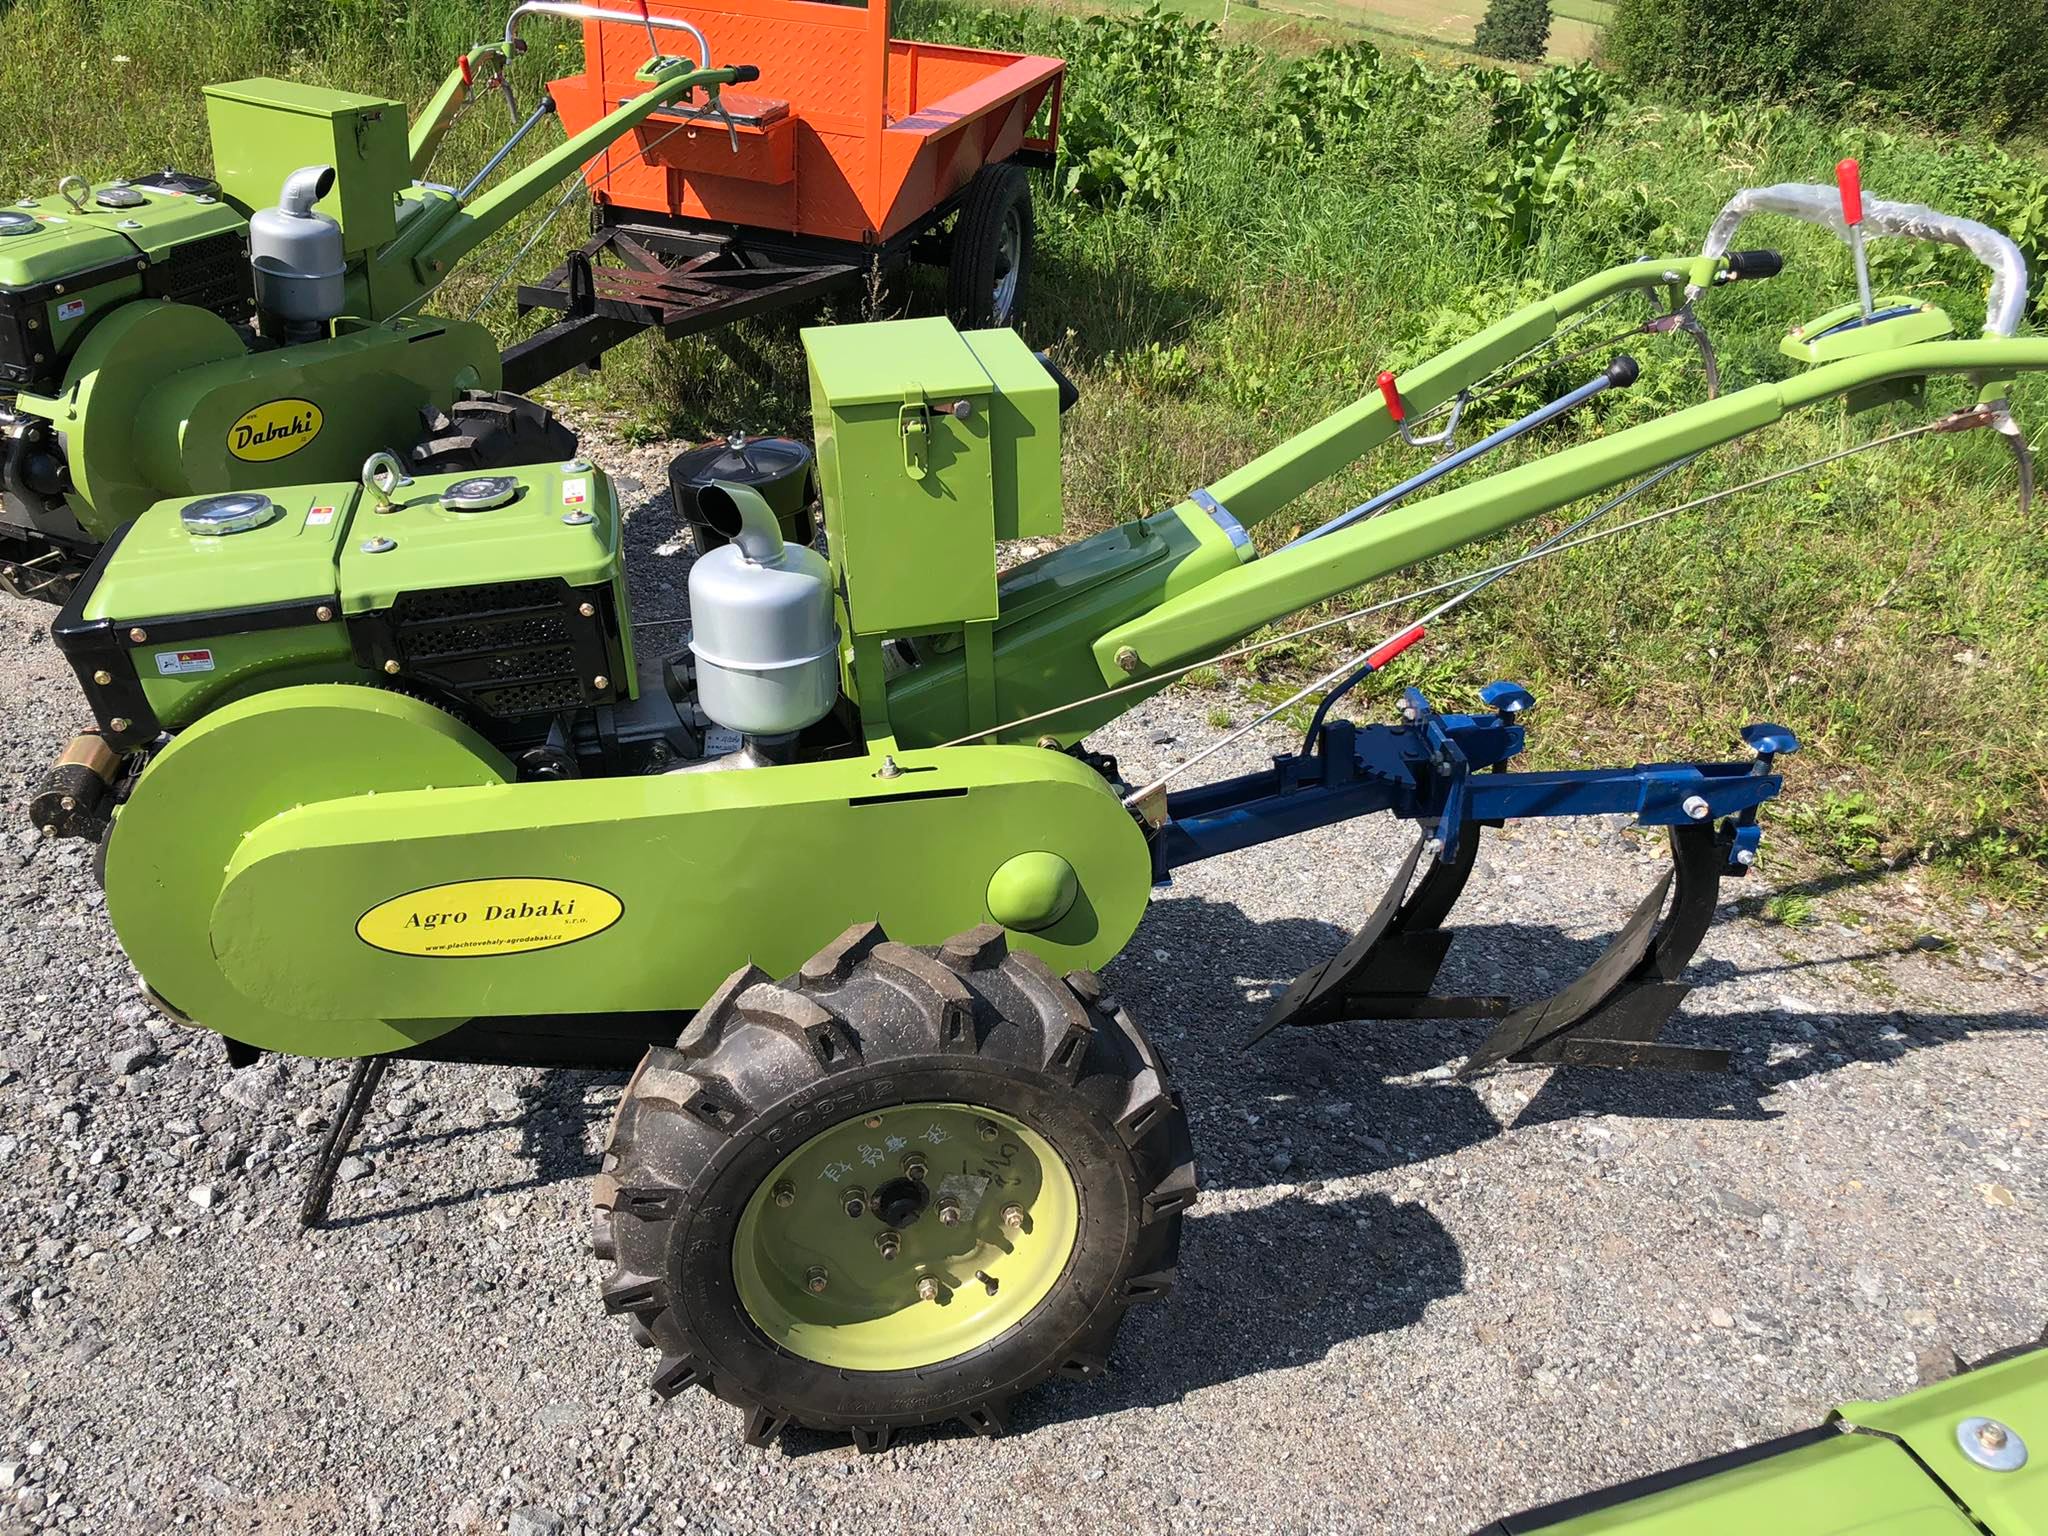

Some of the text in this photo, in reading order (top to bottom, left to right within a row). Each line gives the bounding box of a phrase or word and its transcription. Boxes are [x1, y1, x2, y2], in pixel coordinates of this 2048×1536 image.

[235, 411, 312, 450] Dabaki
[403, 899, 575, 930] Agro Dabaki
[425, 934, 562, 951] www.plachtovehaly-agrodabaki.cz
